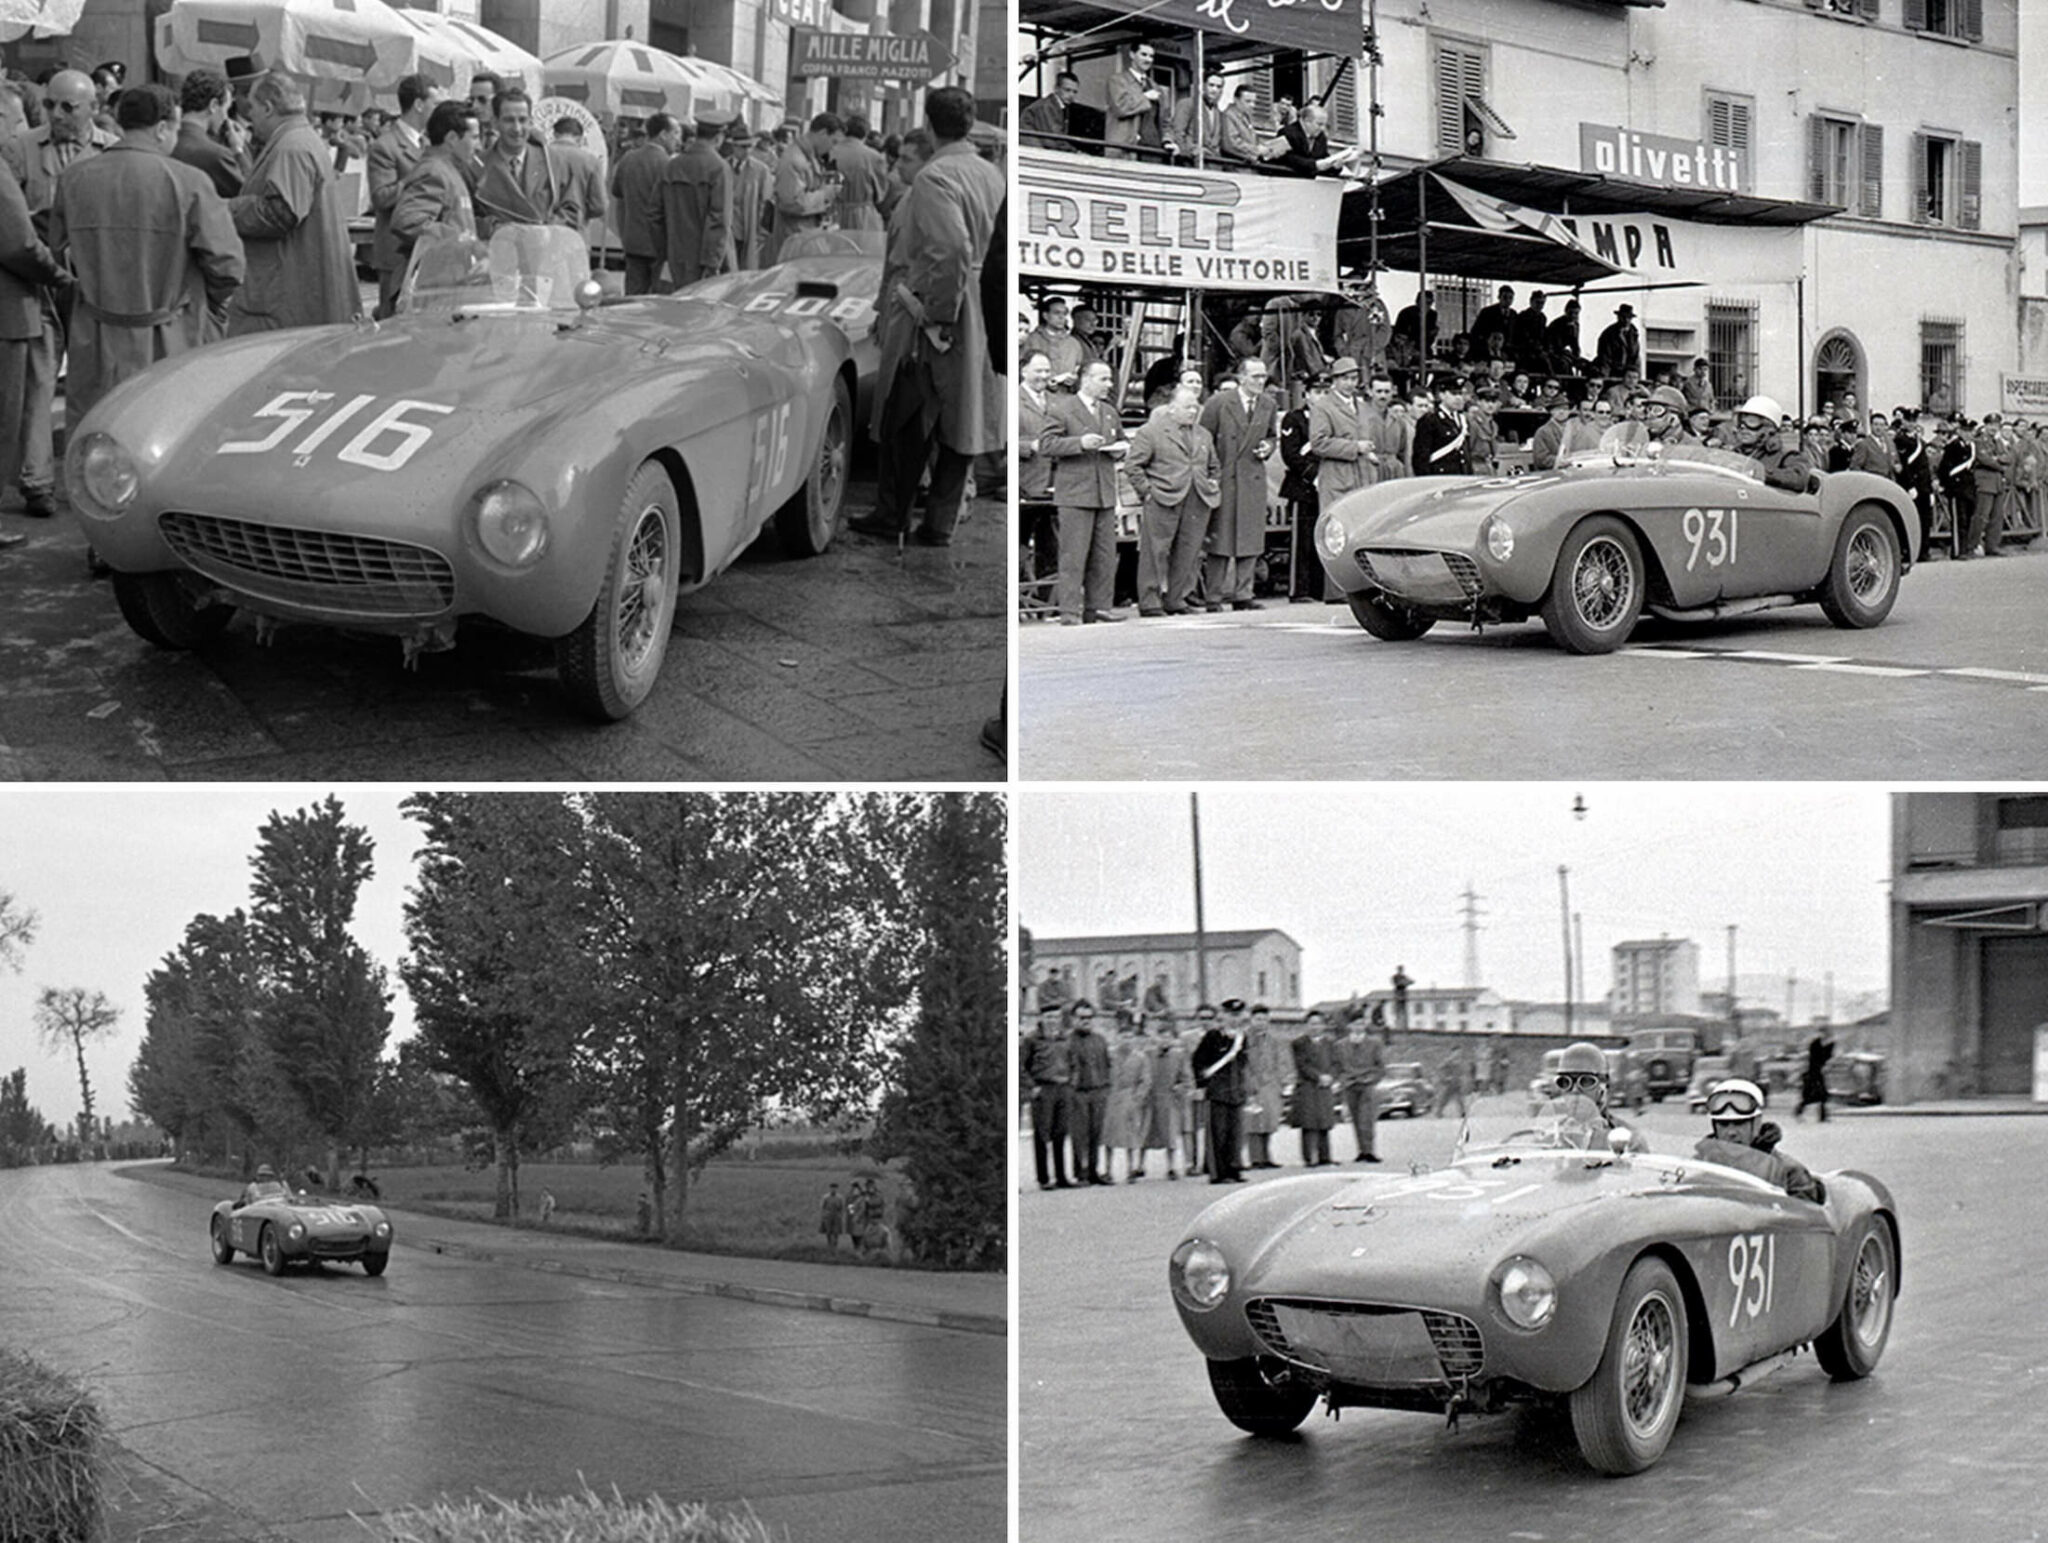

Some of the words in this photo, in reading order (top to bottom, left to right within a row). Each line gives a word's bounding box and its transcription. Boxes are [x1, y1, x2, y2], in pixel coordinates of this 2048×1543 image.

[807, 35, 862, 59] MILLE
[866, 38, 929, 64] MIGLIA
[837, 64, 878, 77] FRANCO
[1595, 132, 1739, 191] olivetti
[1028, 191, 1235, 251] RELLI
[1018, 241, 1085, 269] TICO
[1102, 250, 1183, 276] DELLE
[1196, 256, 1310, 281] VITTORIE
[216, 391, 457, 471] 516
[749, 402, 791, 505] 516
[1682, 507, 1738, 573] 931
[1728, 1233, 1775, 1328] 931
